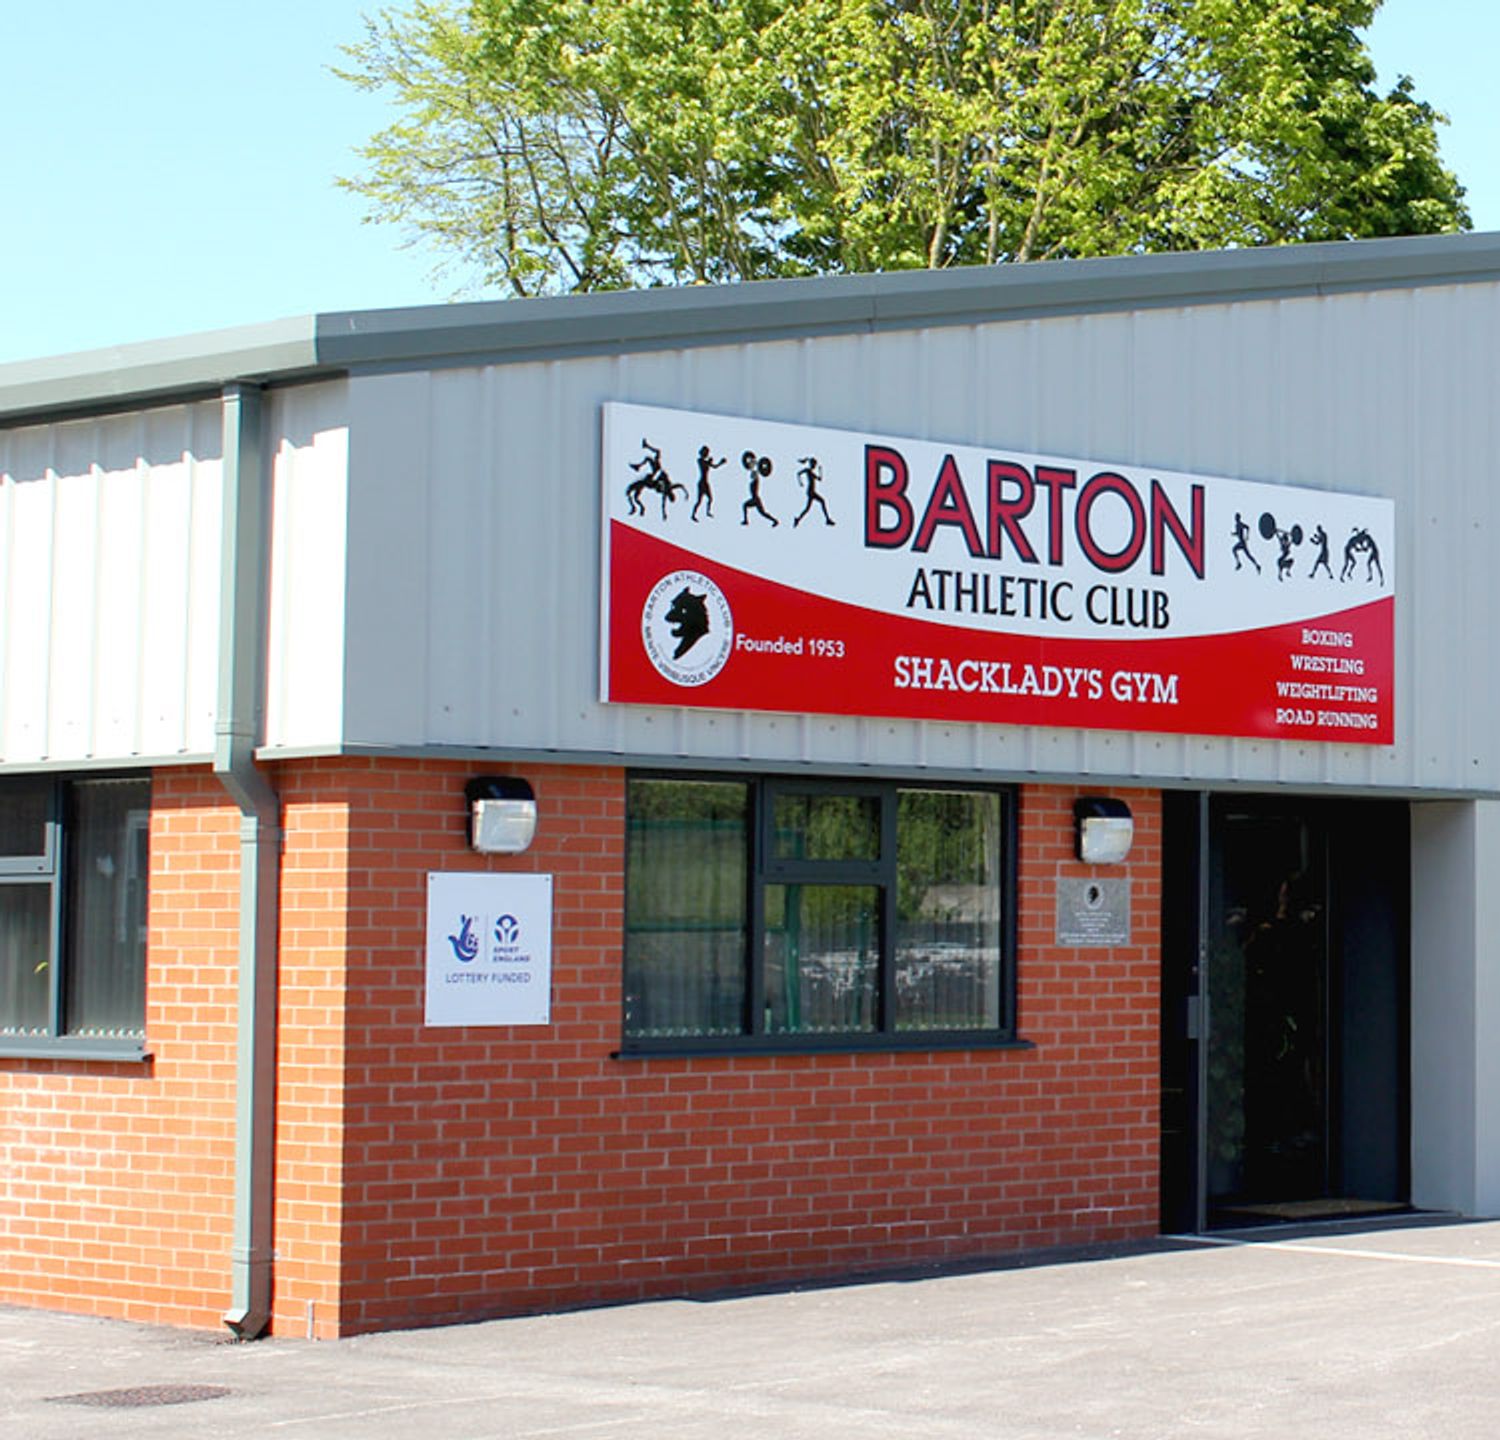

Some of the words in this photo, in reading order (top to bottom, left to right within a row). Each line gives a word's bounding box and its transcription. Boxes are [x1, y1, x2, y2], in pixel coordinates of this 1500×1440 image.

[864, 443, 1205, 580] BARTON
[906, 568, 1074, 622] ATHLETIC
[1085, 584, 1171, 629] CLUB
[735, 633, 804, 655] Founded
[808, 637, 846, 657] 1953
[1302, 629, 1353, 648] BOXING
[1290, 654, 1364, 675] WRESTLING
[893, 655, 1102, 701] SHACKLADY'S
[1110, 670, 1180, 704] GYM
[1276, 682, 1378, 704] WEIGHTLIFTING
[1276, 708, 1315, 726] ROAD
[1317, 711, 1378, 730] RUNNING
[446, 972, 489, 984] LOTTERY
[491, 972, 531, 983] FUNDED
